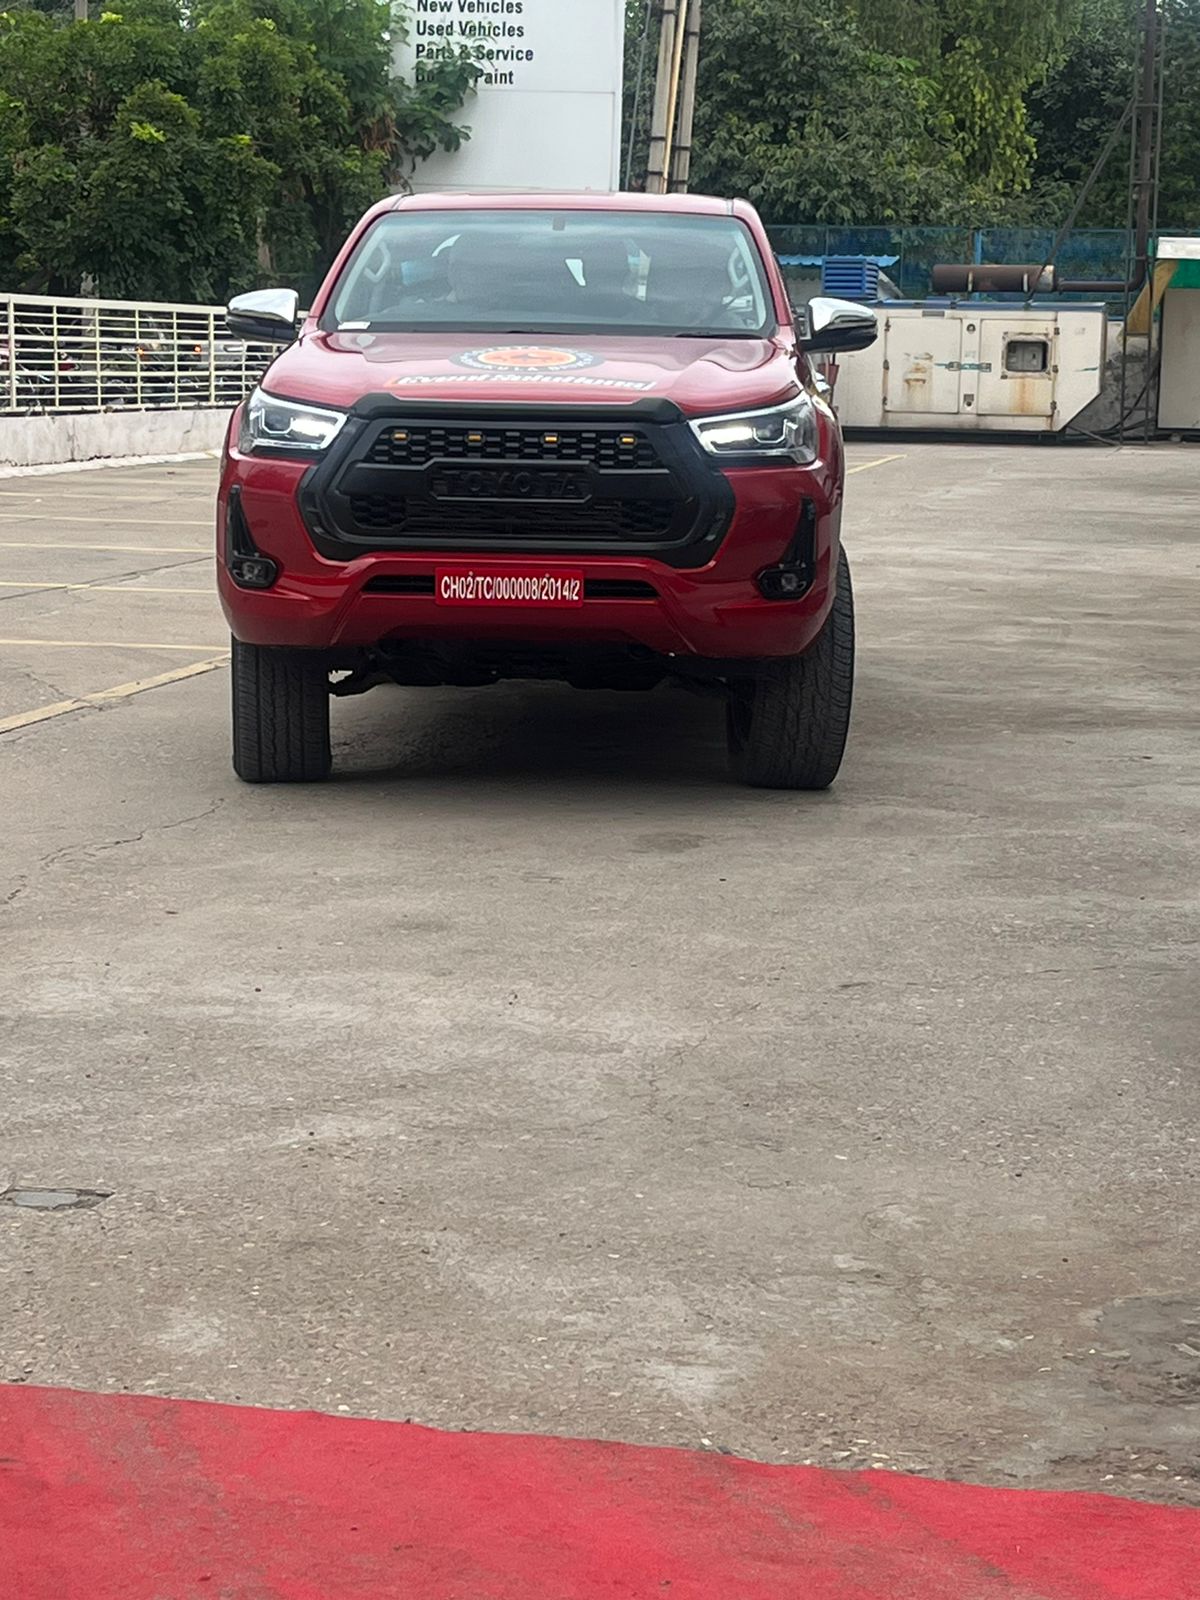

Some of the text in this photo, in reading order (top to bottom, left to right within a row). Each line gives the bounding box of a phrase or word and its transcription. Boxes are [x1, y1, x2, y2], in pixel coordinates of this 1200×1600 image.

[417, 0, 523, 13] New Vehicles
[416, 20, 525, 37] Used Vehicles
[416, 44, 455, 60] Parts
[476, 45, 534, 61] Service
[441, 470, 582, 496] TOYOTA
[441, 576, 580, 601] CH02/TC/000008/2014/2
